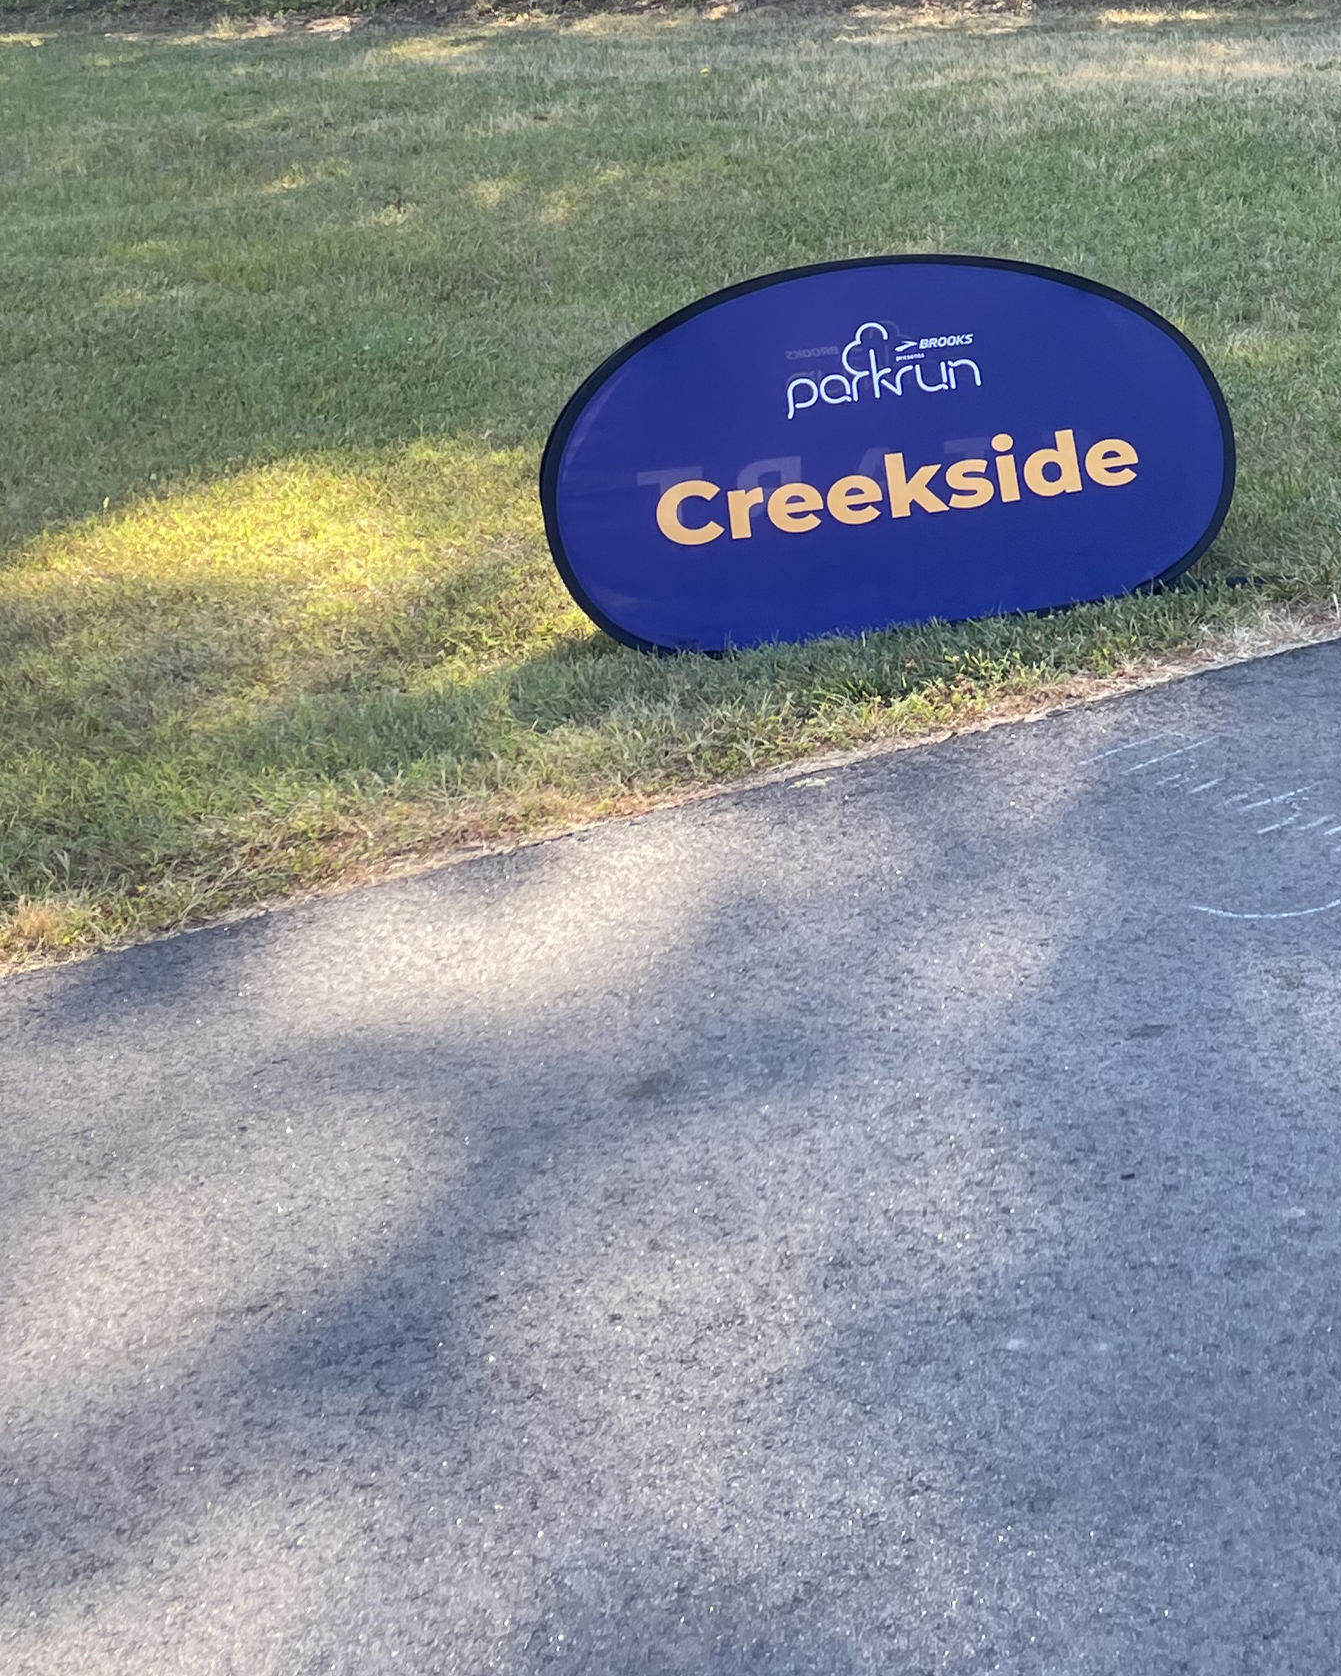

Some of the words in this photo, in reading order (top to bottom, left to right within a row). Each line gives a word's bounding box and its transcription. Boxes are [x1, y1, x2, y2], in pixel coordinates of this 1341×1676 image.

[895, 352, 926, 362] presents
[919, 333, 974, 350] BROOKS
[786, 348, 983, 420] parkrun
[655, 428, 1140, 546] Creekside
